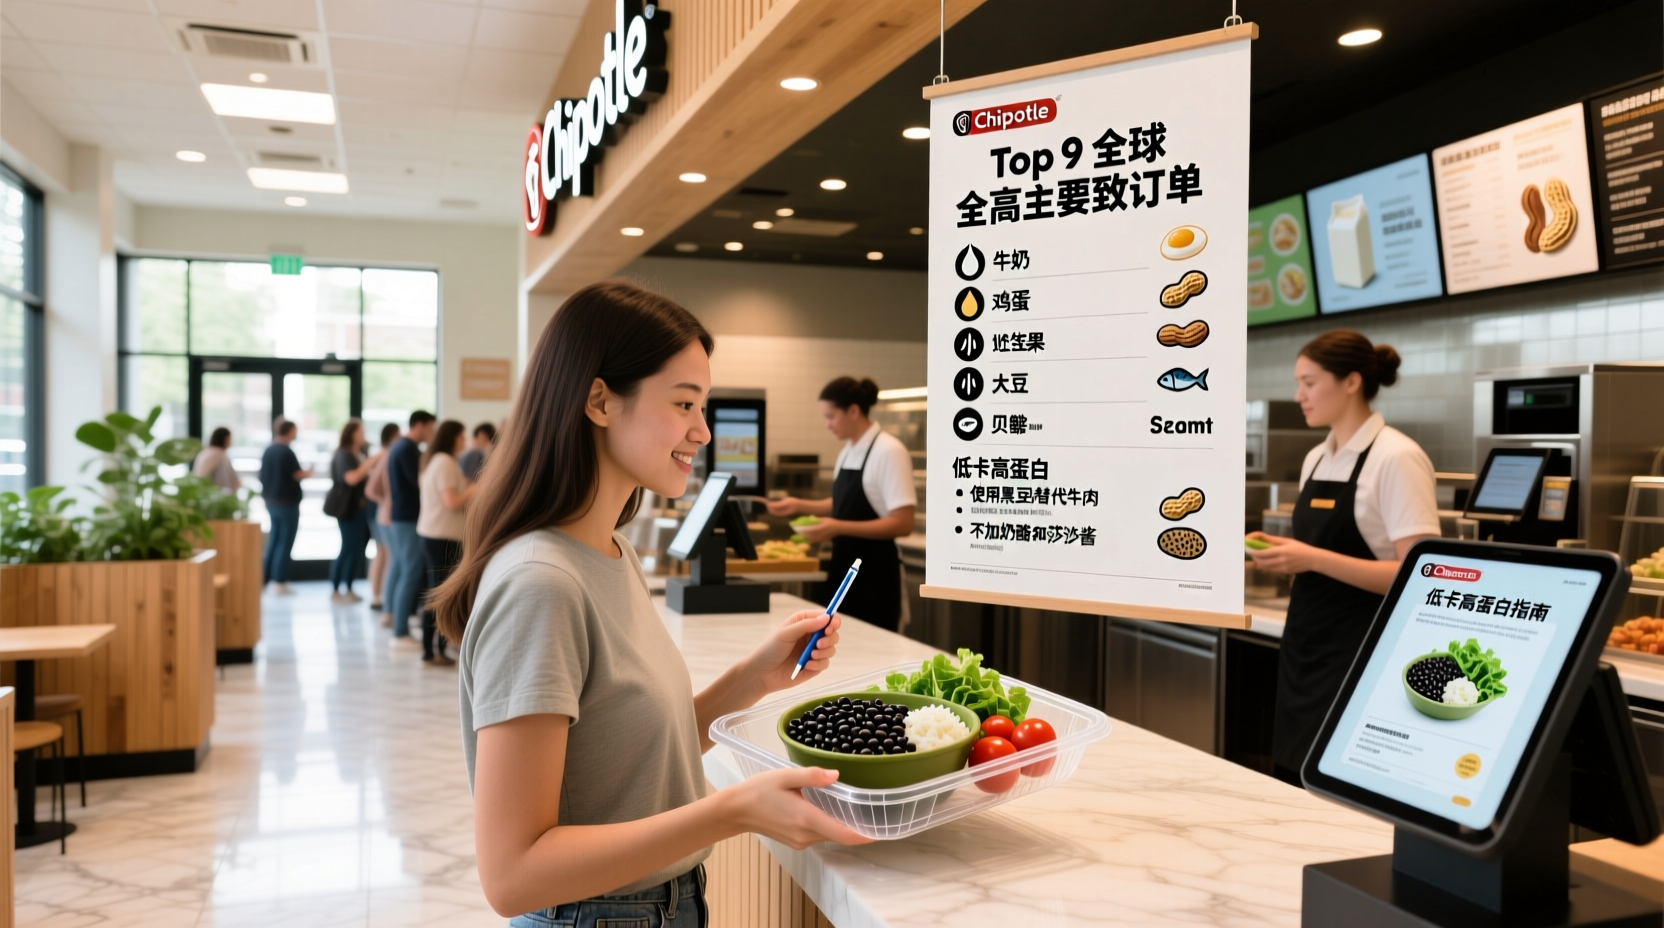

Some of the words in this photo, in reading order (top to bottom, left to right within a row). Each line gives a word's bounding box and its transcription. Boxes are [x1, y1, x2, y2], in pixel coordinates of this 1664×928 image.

[541, 0, 647, 200] Chipotle
[974, 103, 1049, 130] Chipotle
[990, 146, 1054, 181] Top
[1061, 137, 1083, 169] 9
[1092, 121, 1167, 169] 全球
[956, 163, 1203, 228] 全高主要致订单
[993, 249, 1030, 271] 牛奶
[992, 290, 1031, 312] 鸡蛋
[992, 373, 1029, 394] 大豆
[952, 456, 1049, 480] 低卡高蛋白
[1425, 587, 1552, 623] 低卡高蛋白指南
